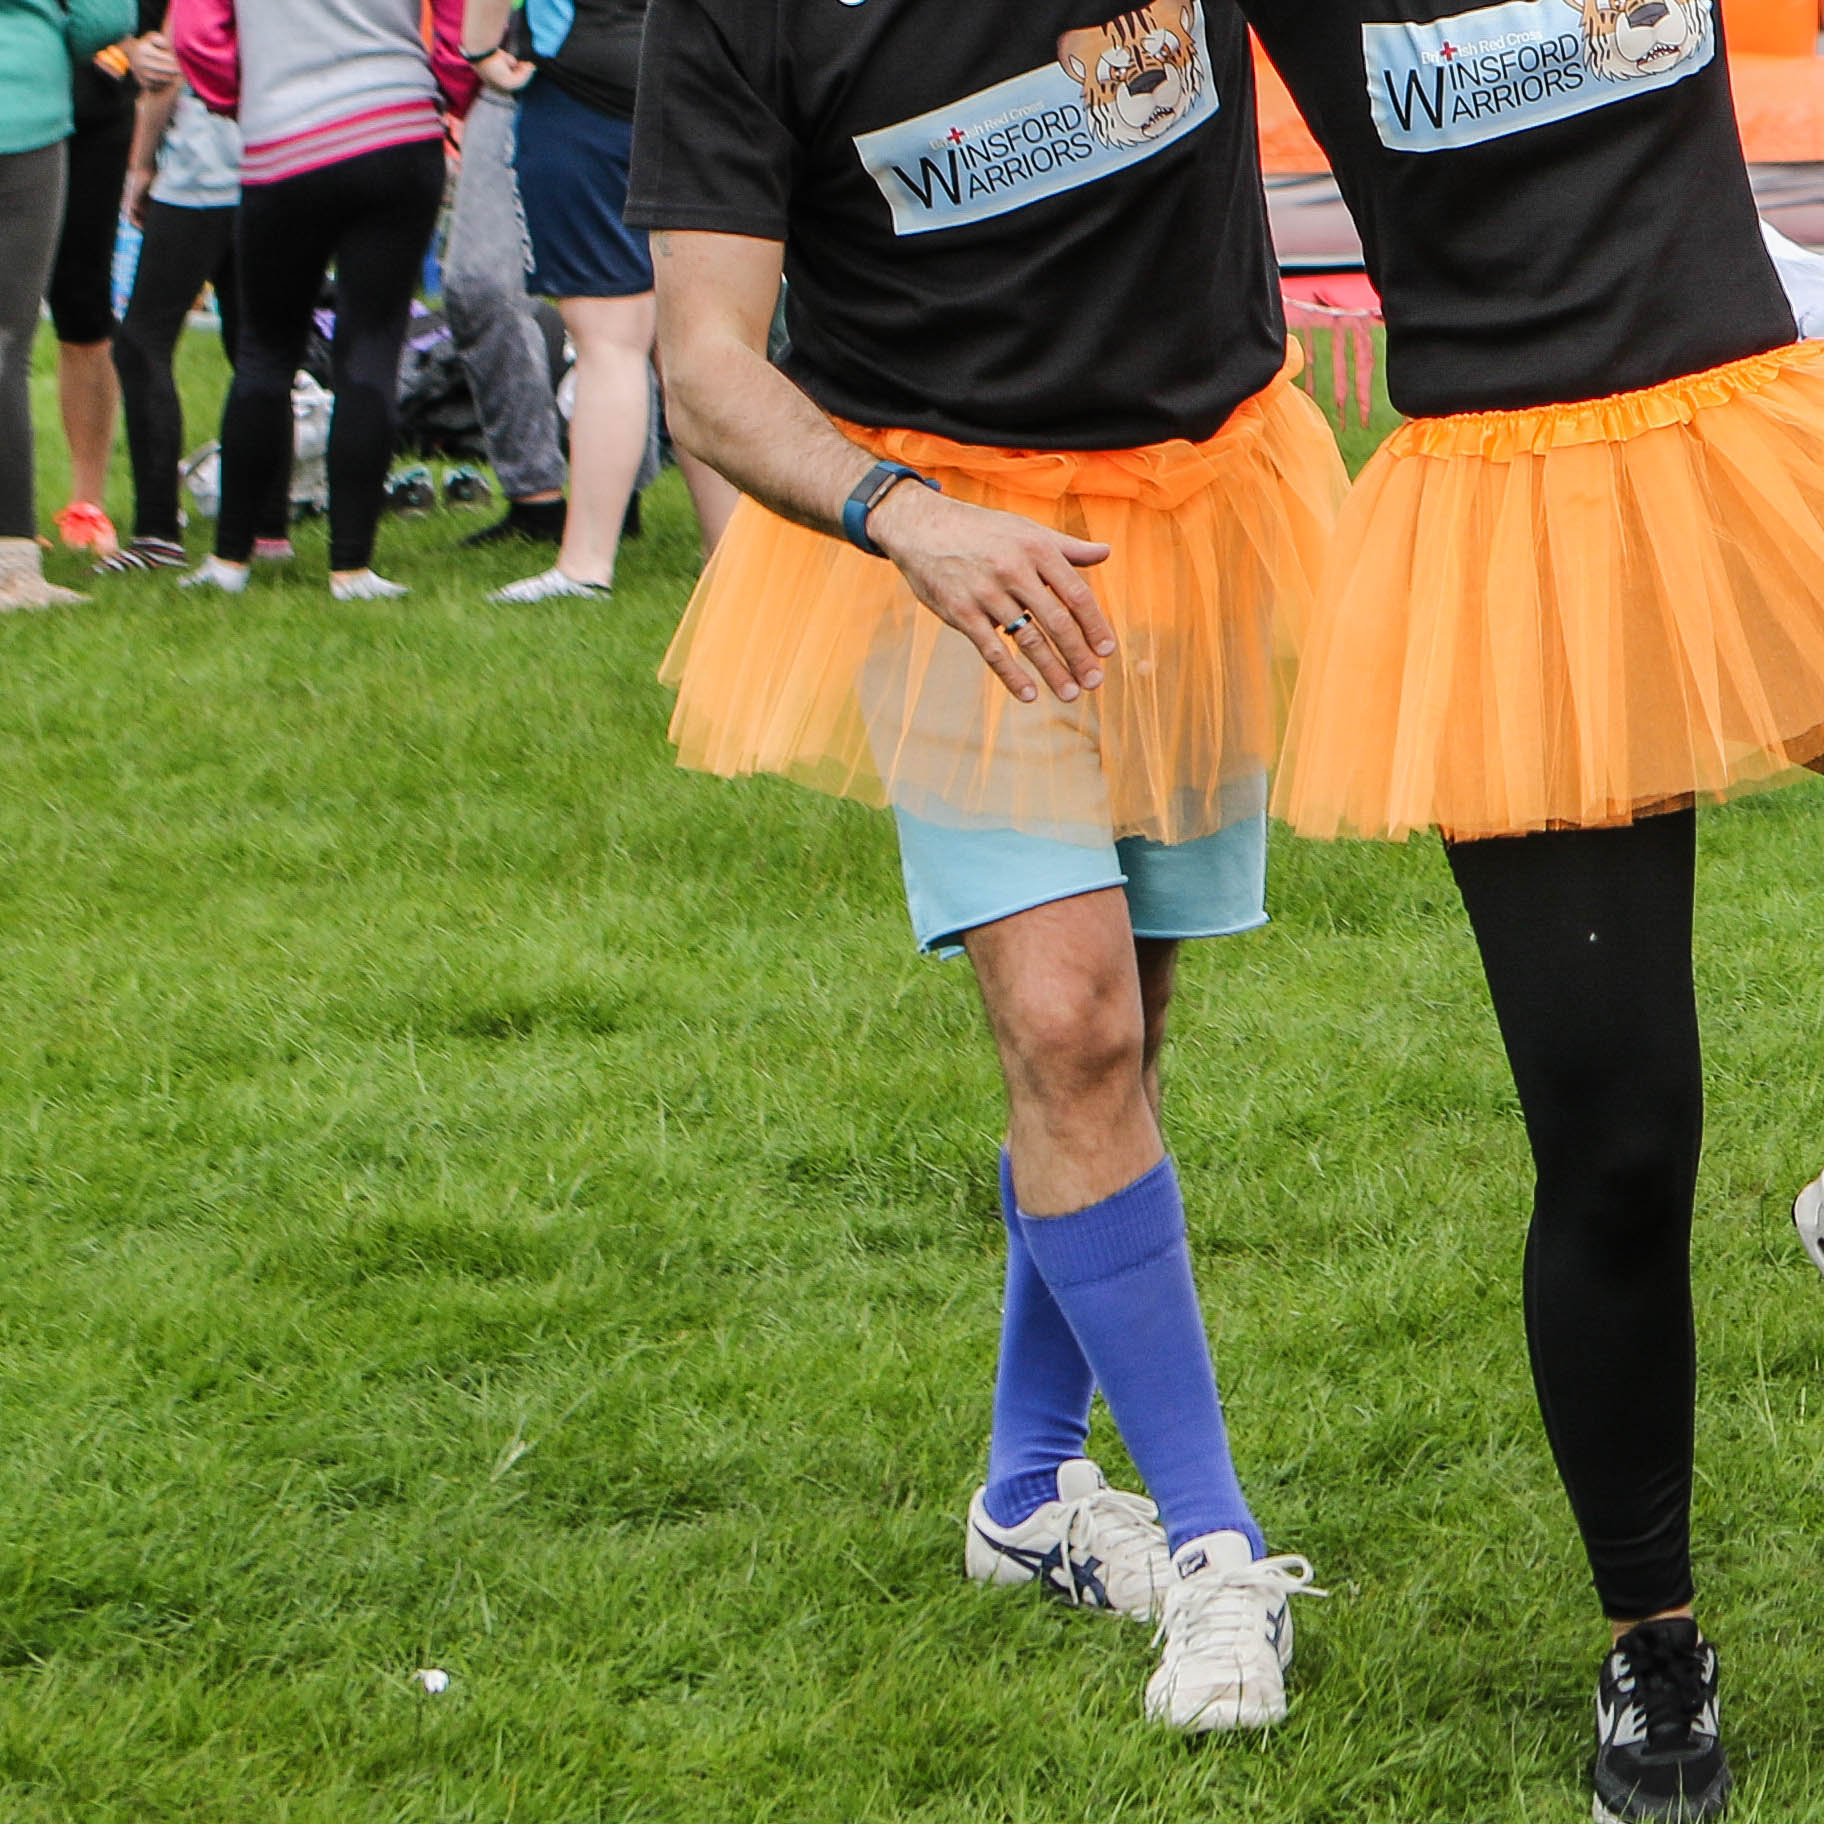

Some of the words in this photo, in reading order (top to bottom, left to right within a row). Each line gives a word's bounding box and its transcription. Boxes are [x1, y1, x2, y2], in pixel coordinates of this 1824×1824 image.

[1383, 34, 1579, 131] WINSFORD
[1479, 37, 1505, 55] Red
[1506, 30, 1544, 46] Cross
[892, 104, 1082, 209] WINSFORD
